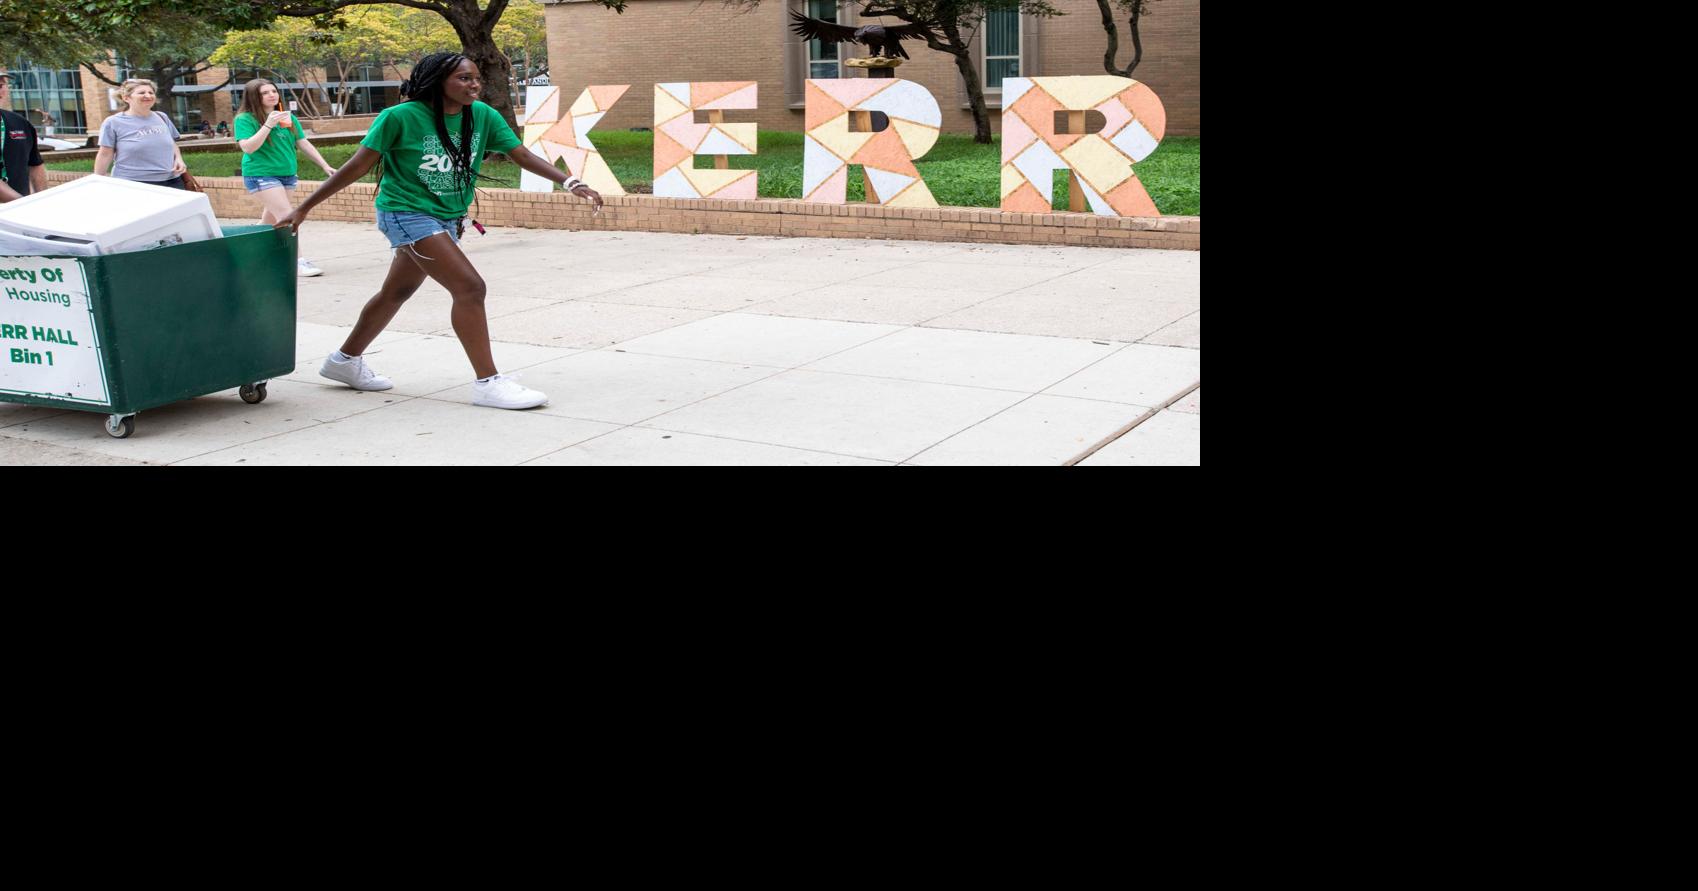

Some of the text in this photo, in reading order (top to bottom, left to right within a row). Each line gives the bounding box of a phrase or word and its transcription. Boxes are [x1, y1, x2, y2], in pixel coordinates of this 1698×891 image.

[519, 74, 1167, 217] KERR
[41, 267, 64, 283] Of
[5, 287, 71, 307] Housing
[0, 324, 79, 346] RR HALL
[10, 347, 54, 366] Bin 1
